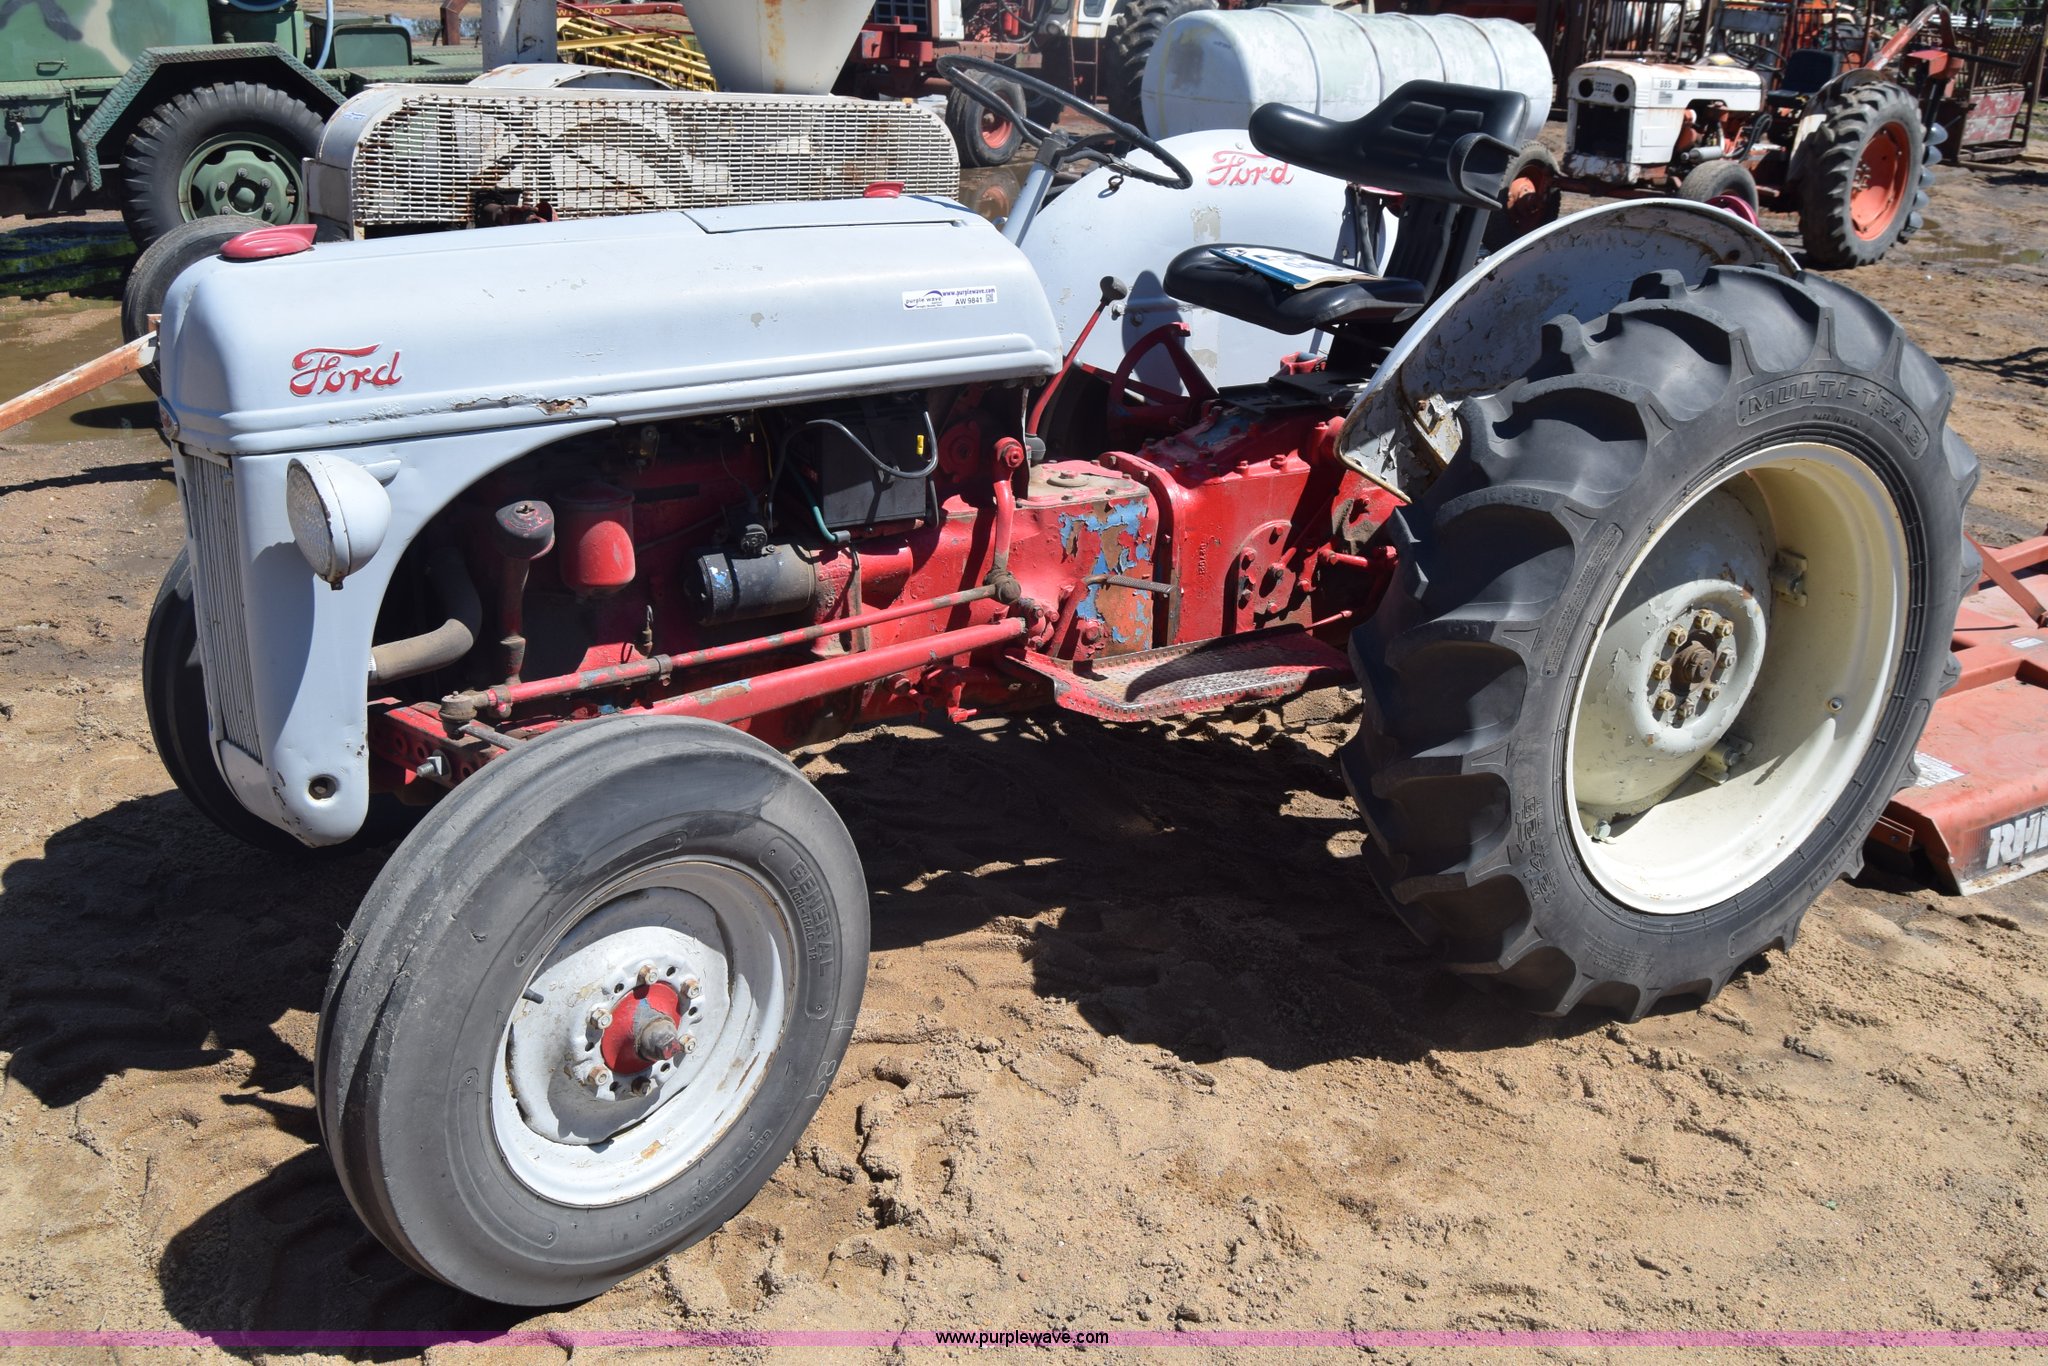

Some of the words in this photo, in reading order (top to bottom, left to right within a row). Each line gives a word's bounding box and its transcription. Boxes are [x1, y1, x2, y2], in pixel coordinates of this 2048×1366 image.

[1207, 151, 1294, 186] Ford
[905, 297, 925, 305] purple
[943, 288, 996, 297] www.purplewave.com
[955, 298, 967, 306] AW
[967, 296, 983, 305] 9841
[290, 343, 403, 398] Ford
[788, 887, 815, 942] AGRI-TRAC
[789, 860, 834, 978] GENERAL
